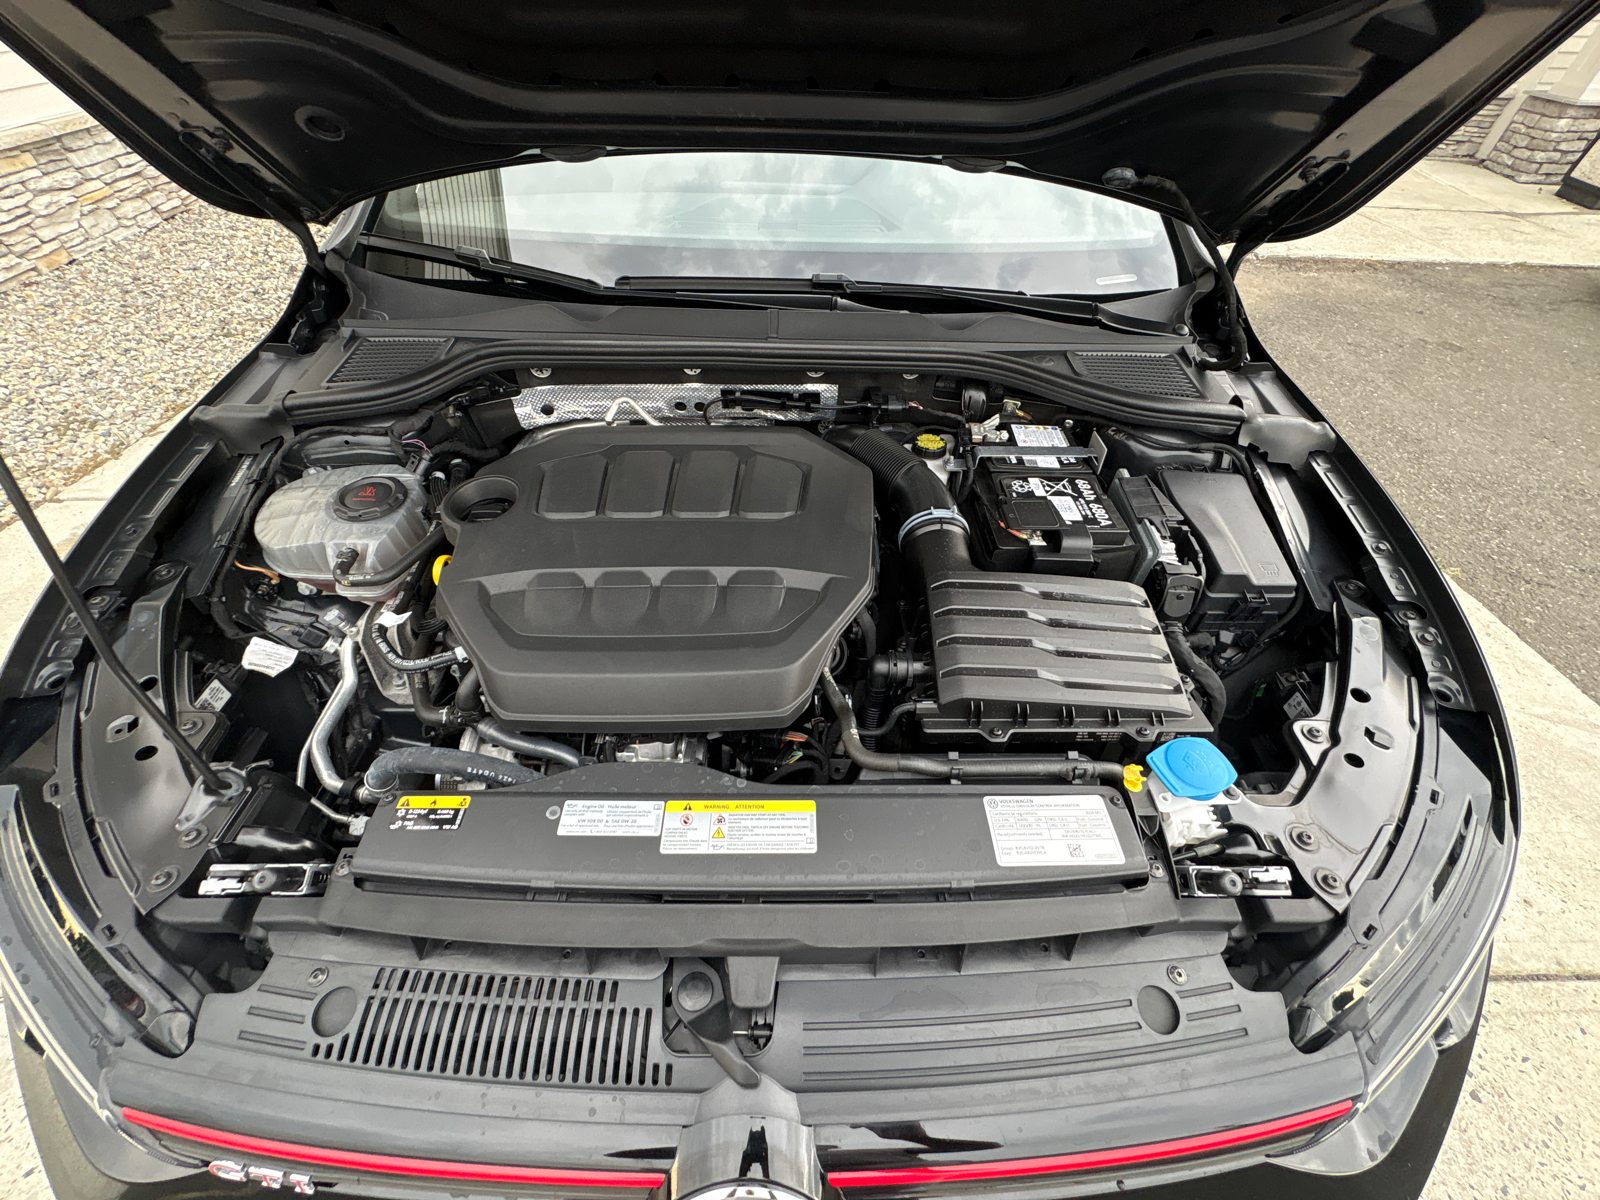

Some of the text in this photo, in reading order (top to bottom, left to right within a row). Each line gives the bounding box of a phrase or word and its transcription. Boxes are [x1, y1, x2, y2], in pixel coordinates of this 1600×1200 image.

[1075, 479, 1096, 500] 68Ah
[1089, 503, 1112, 526] 680A
[208, 1160, 316, 1194] GTI
